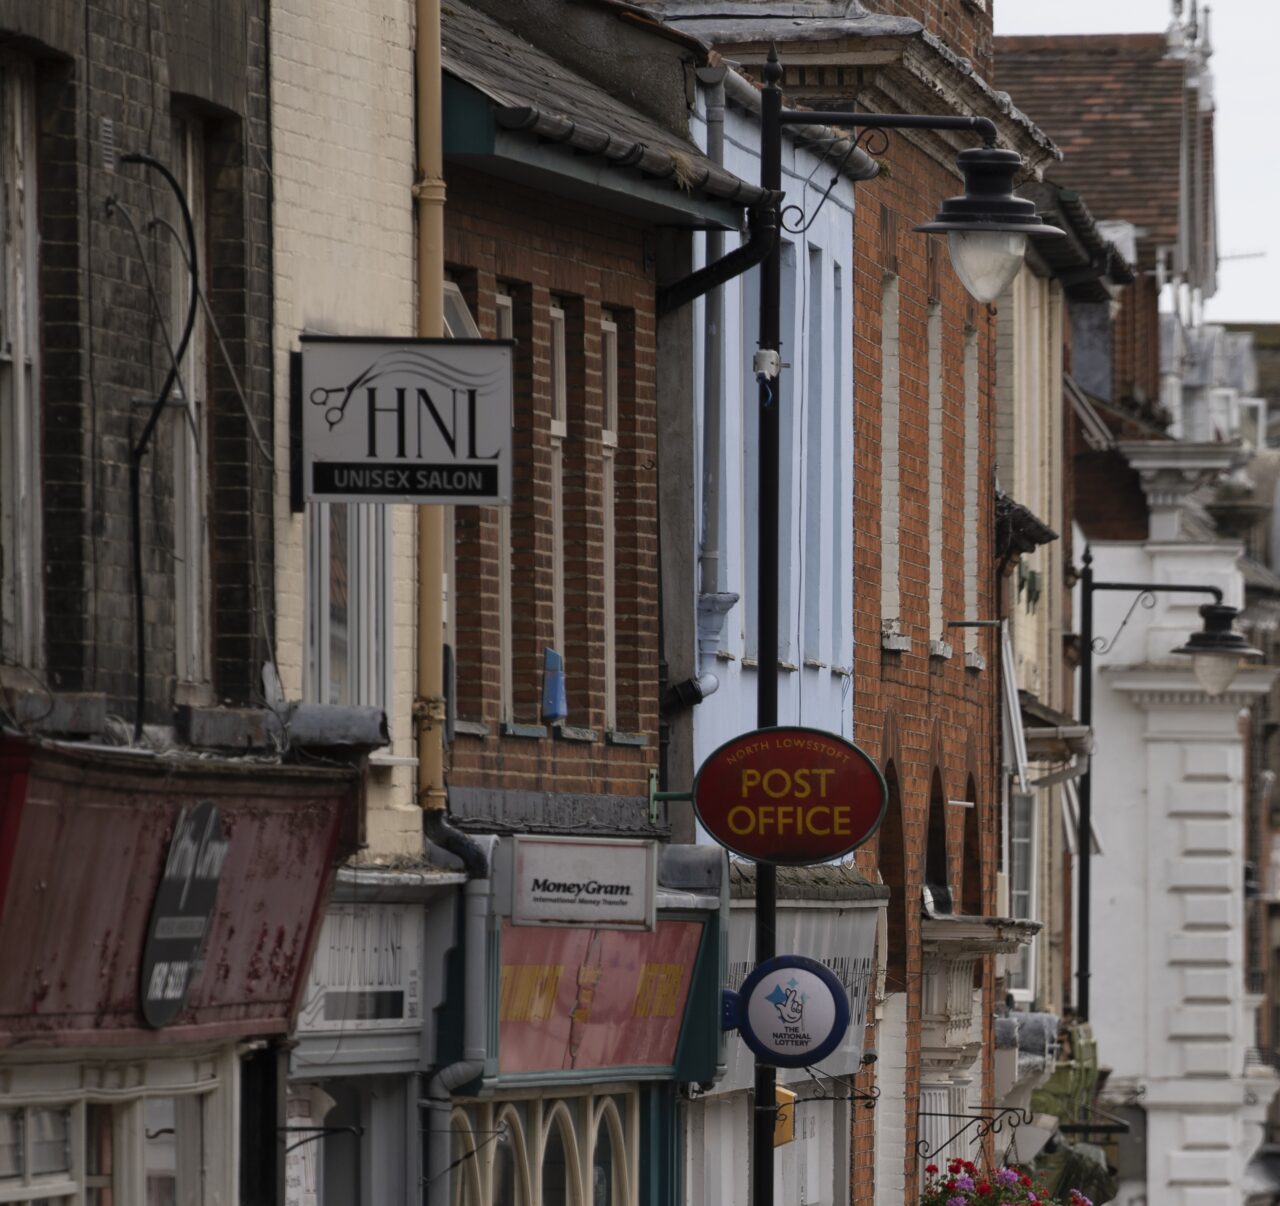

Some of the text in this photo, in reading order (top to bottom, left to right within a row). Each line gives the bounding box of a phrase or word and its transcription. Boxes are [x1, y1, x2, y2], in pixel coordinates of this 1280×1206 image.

[365, 386, 501, 460] HNL
[333, 469, 483, 490] UNISEX SALON
[726, 738, 851, 765] NORTH LOWESTOFT
[741, 768, 836, 799] POST
[727, 805, 852, 836] OFFICE
[531, 878, 631, 896] MoneyGram
